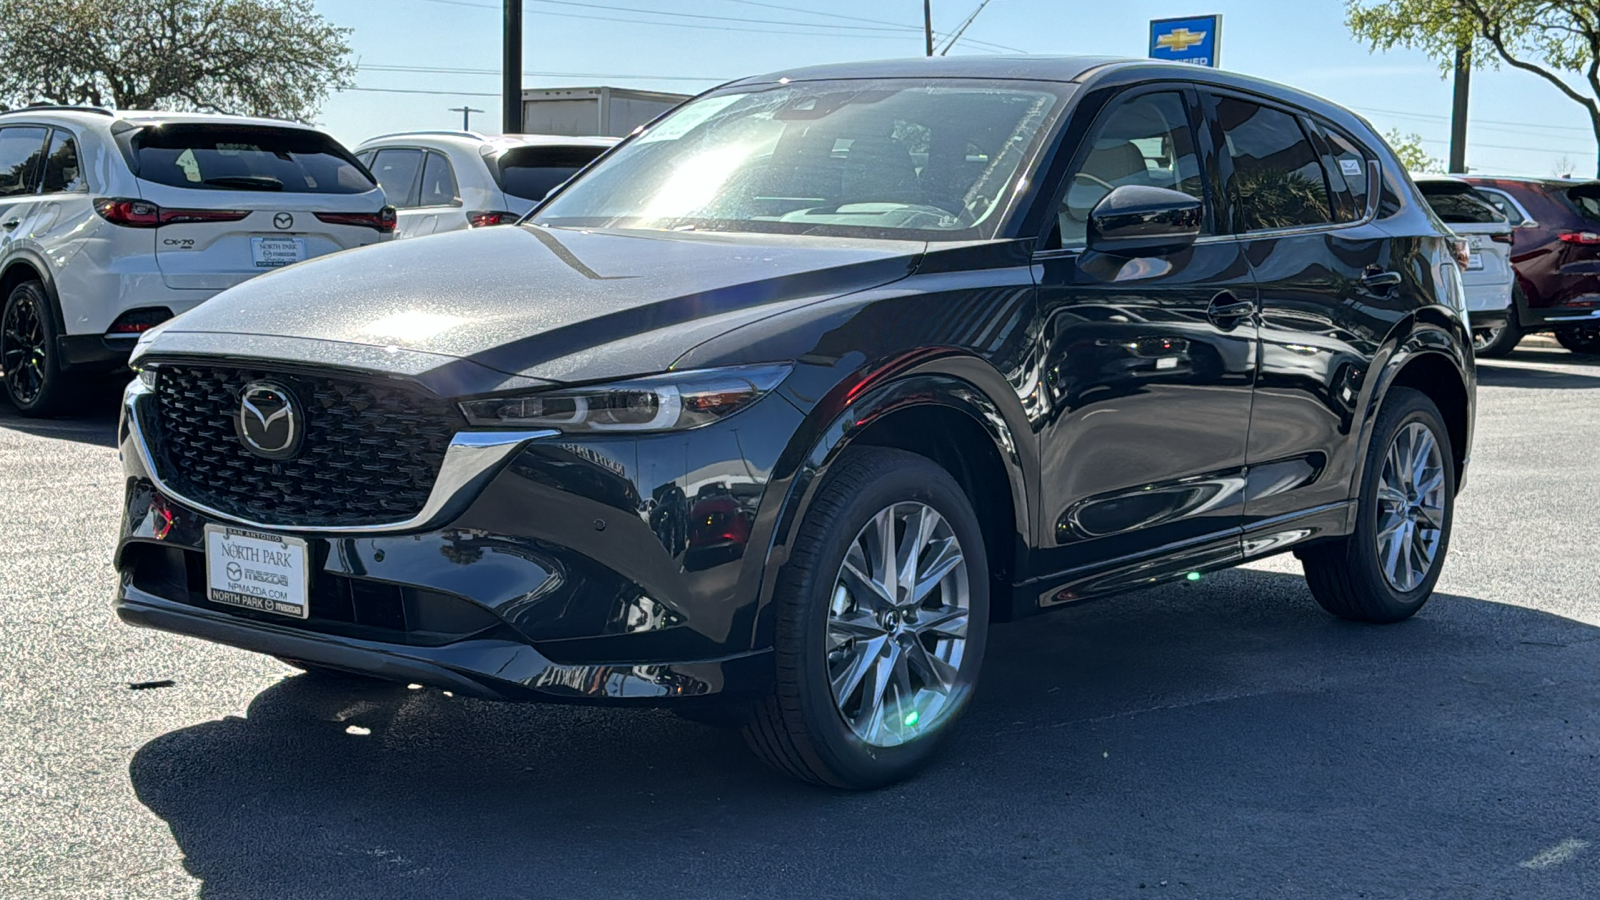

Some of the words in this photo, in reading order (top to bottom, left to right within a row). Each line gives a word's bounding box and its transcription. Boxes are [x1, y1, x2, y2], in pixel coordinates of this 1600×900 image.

[163, 238, 195, 246] CX-70
[245, 531, 281, 542] ANTONIO
[221, 541, 259, 562] NORTH
[263, 549, 292, 568] PARK
[213, 591, 240, 603] NORTH
[242, 596, 263, 608] PARK
